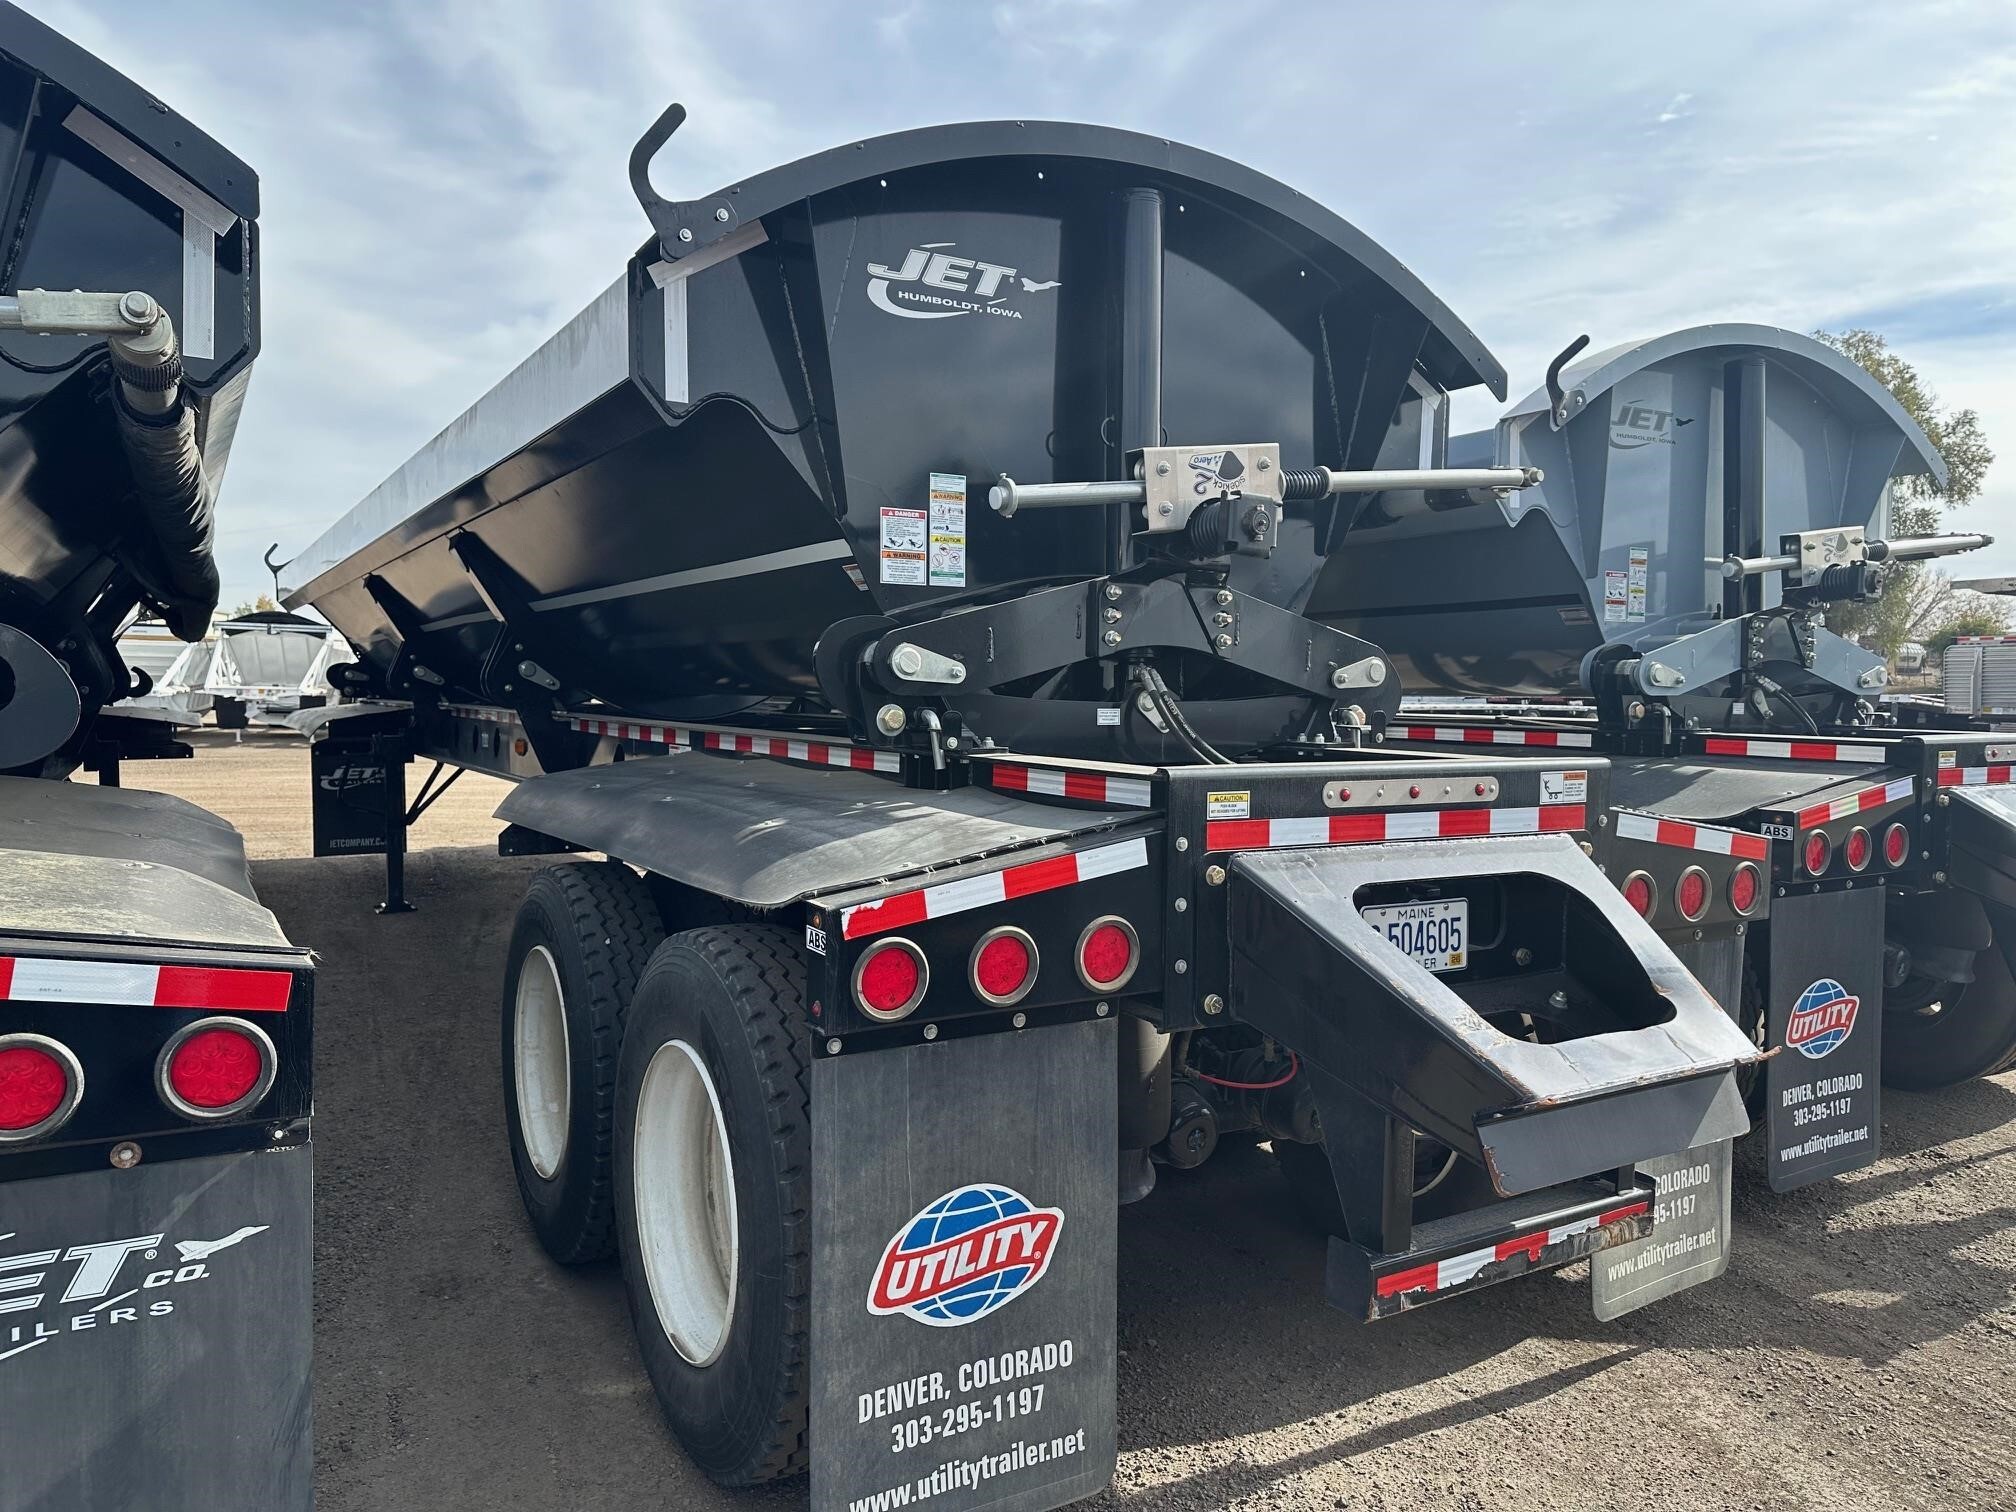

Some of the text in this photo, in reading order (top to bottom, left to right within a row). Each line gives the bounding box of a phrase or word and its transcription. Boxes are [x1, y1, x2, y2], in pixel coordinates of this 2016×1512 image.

[867, 248, 1017, 297] JET
[898, 290, 1023, 320] HUMBOLDT, IOWA
[1611, 405, 1673, 432] JET
[1194, 456, 1213, 466] Aero
[1194, 472, 1213, 495] 2
[320, 768, 379, 780] JET
[1764, 824, 1789, 838] ABS
[1397, 907, 1435, 920] MAINE
[808, 930, 826, 951] ABS
[1388, 916, 1461, 956] 504605
[1791, 1003, 1849, 1040] UTILITY
[1782, 1073, 1863, 1107] DENVER, COLORADO
[1793, 1097, 1851, 1127] 303-295-1197
[1780, 1125, 1868, 1162] www.utilitytrailer.net
[1655, 1163, 1711, 1197] COLORADO
[886, 1220, 1050, 1300] UTILITY
[1608, 1226, 1716, 1282] www.utilitytrailer.net
[142, 1263, 211, 1289] CO.
[11, 1300, 175, 1342] ILERS
[858, 1339, 1073, 1424] DENVER, COLORADO
[891, 1384, 1045, 1453] 303-295-1197
[849, 1428, 1085, 1512] www.utilitytrailer.net
